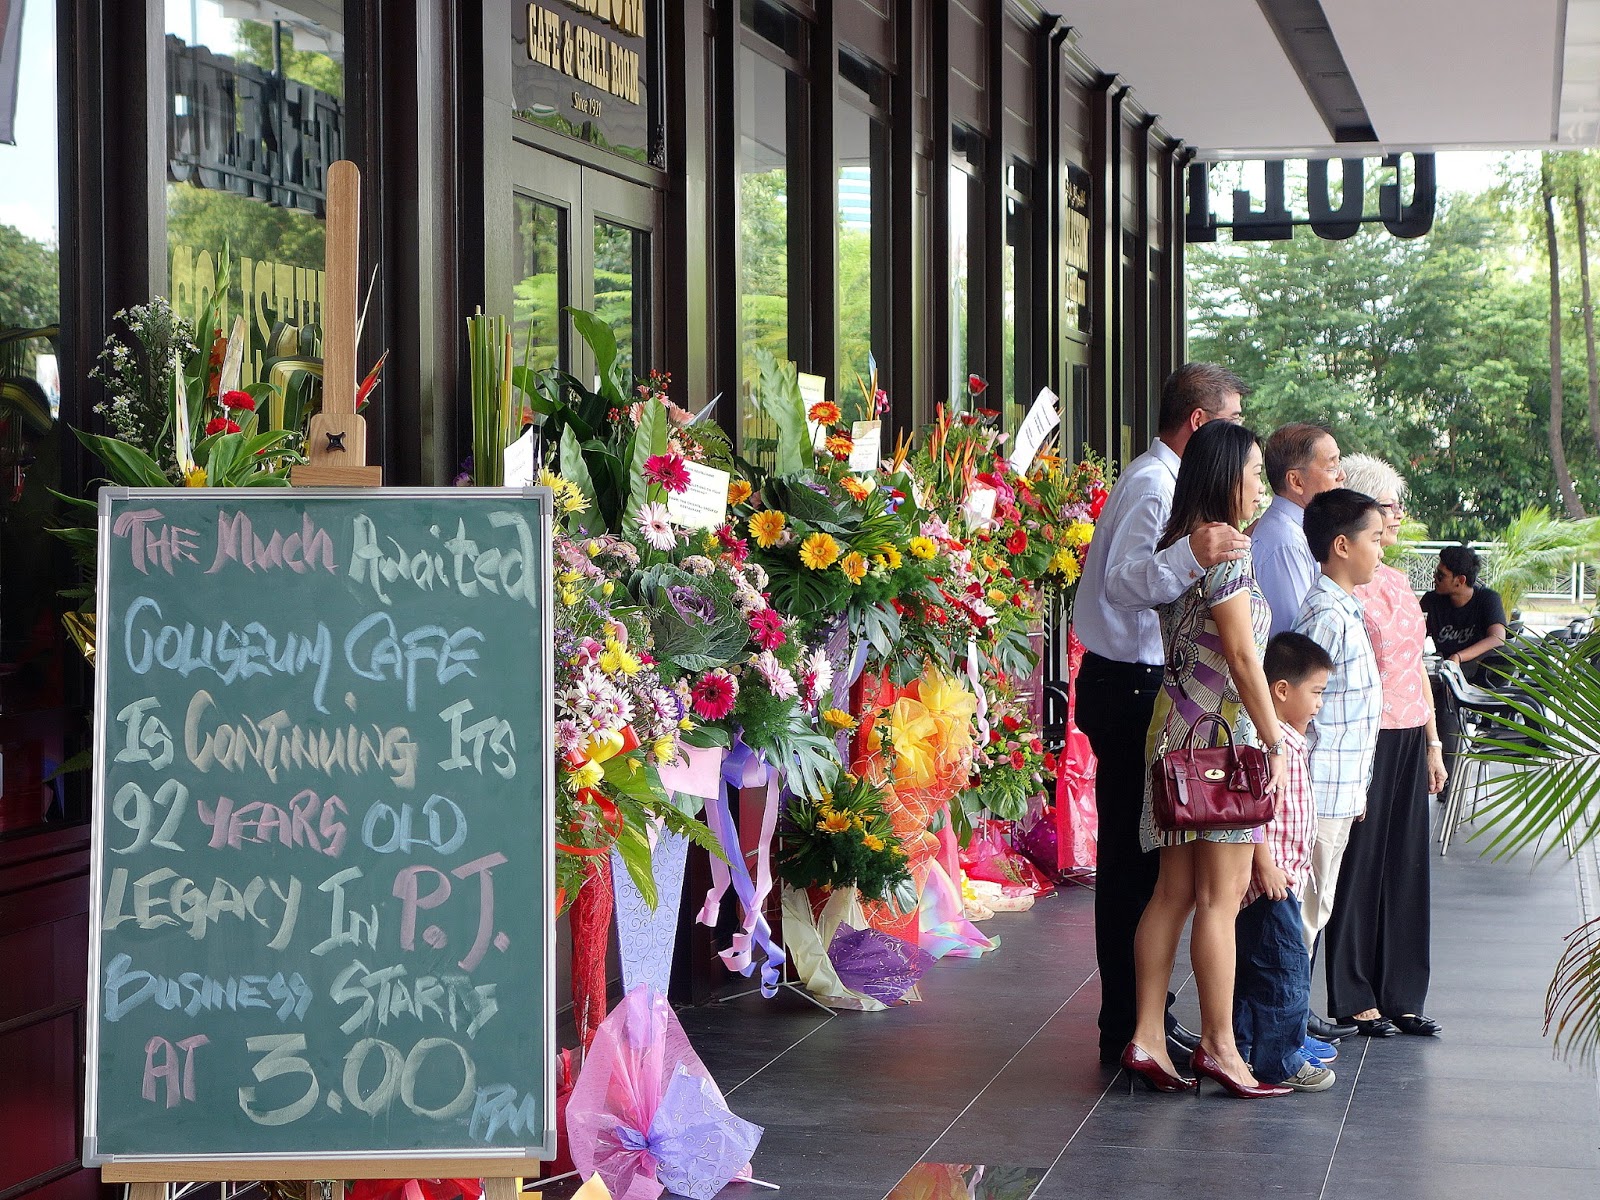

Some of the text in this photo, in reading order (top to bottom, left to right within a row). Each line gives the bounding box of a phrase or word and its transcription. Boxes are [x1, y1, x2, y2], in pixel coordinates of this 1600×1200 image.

[528, 3, 561, 71] CAFE
[563, 20, 574, 77] &
[576, 25, 609, 92] GRILL
[610, 42, 640, 105] ROOM
[573, 91, 602, 118] Since 1921
[113, 508, 537, 608] THE Much Awaited
[124, 595, 486, 714] COLISEUM CAFE
[110, 779, 468, 858] 92 YEARS OLD
[102, 866, 301, 952] LEGACY
[393, 852, 510, 972] P.J.
[104, 952, 498, 1040] BUSINESS STARTS
[142, 1035, 211, 1109] AT
[239, 1033, 476, 1126] 3.00
